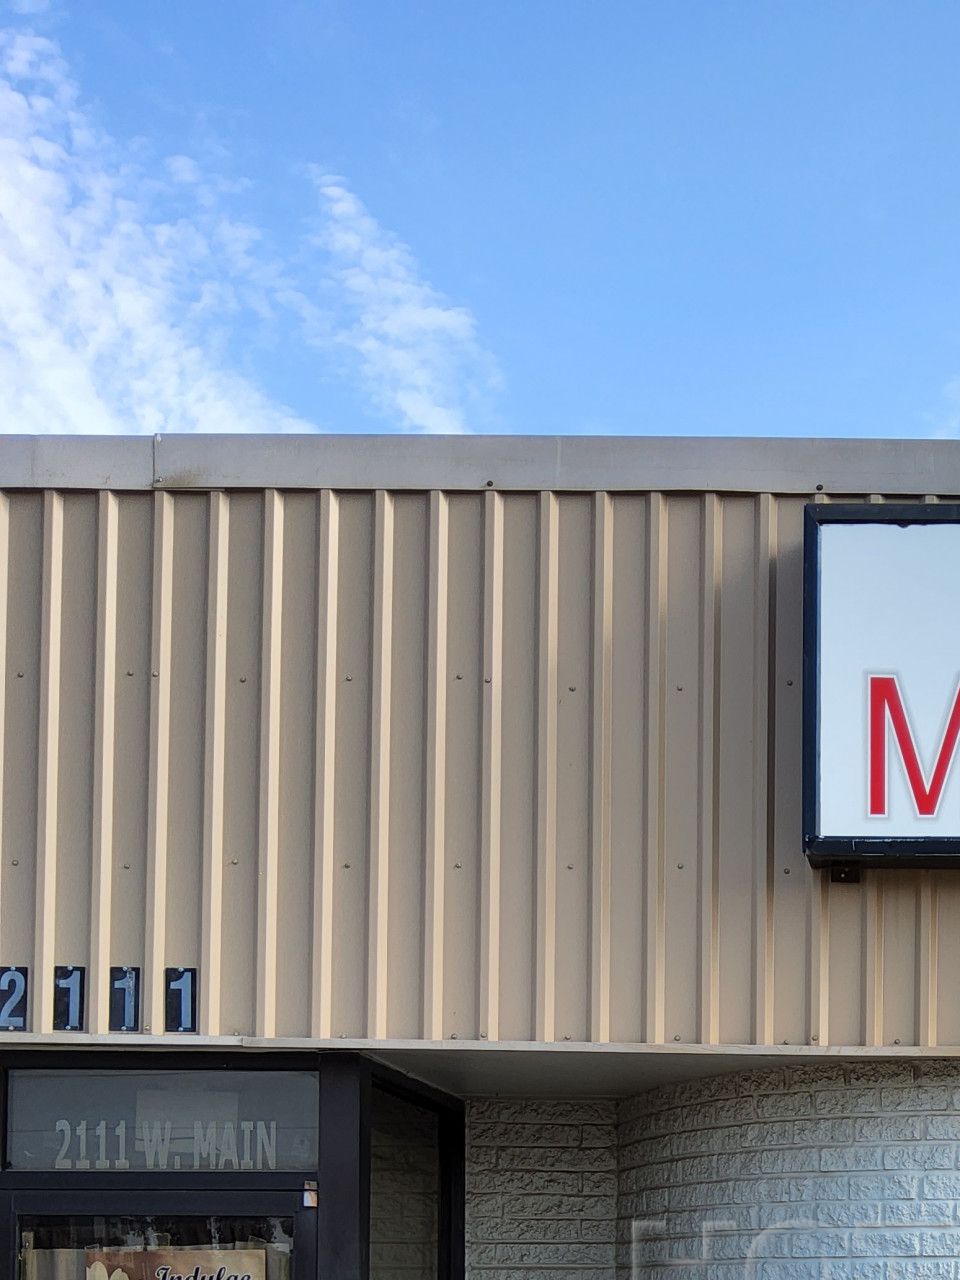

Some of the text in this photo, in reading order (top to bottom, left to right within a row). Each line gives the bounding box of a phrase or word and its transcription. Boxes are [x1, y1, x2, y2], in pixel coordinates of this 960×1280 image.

[0, 969, 194, 1029] 2111
[55, 1119, 277, 1169] 2111 W. MAIN
